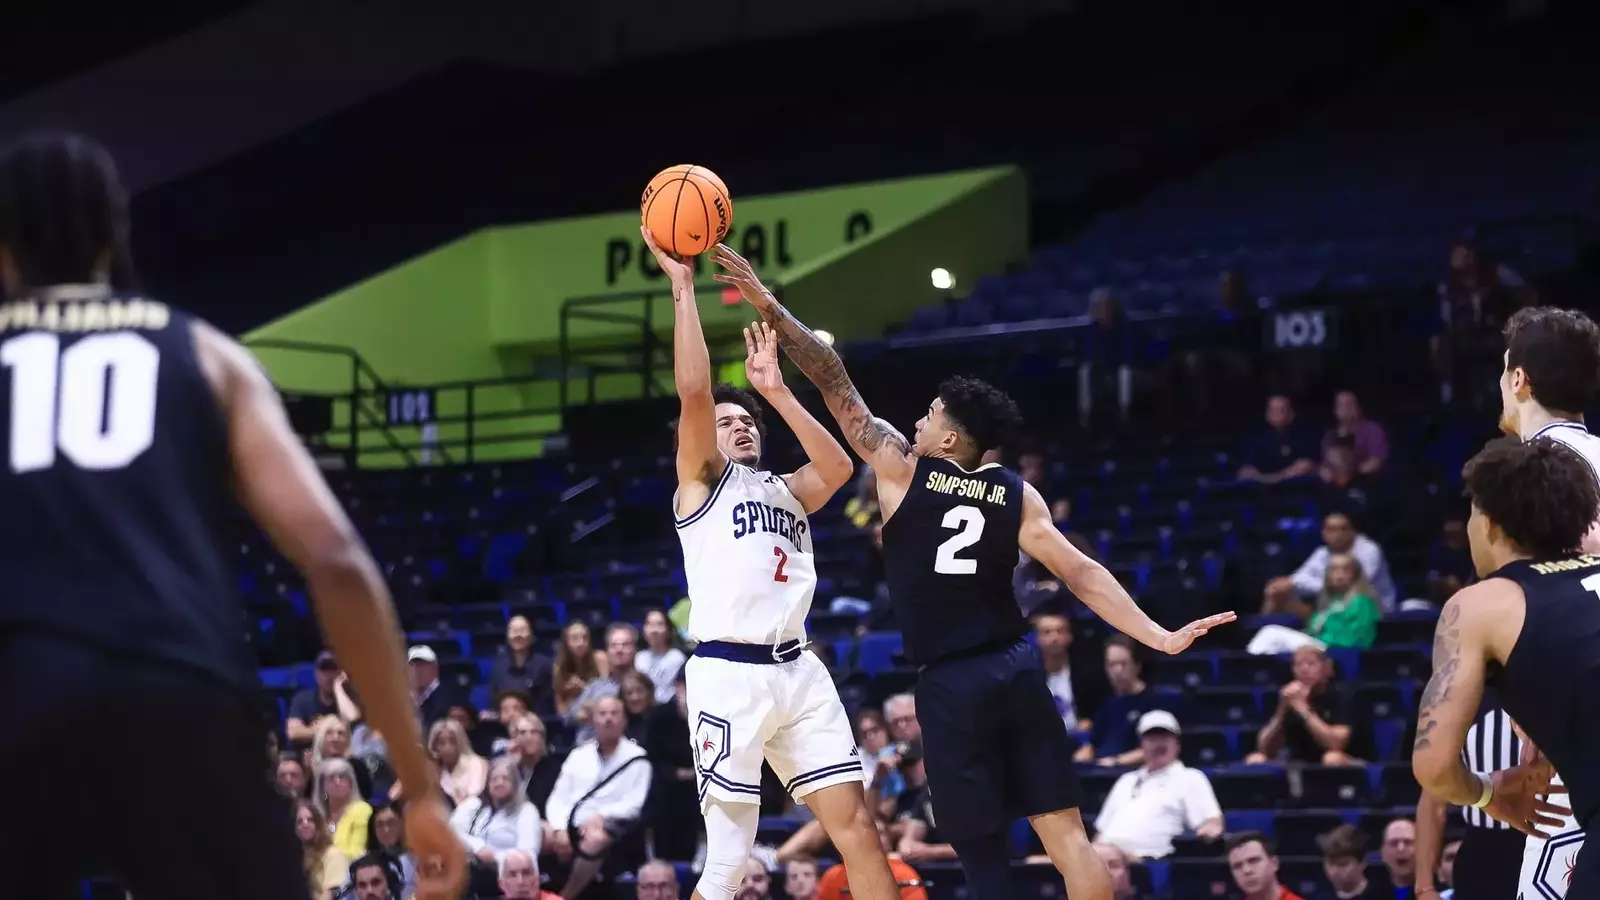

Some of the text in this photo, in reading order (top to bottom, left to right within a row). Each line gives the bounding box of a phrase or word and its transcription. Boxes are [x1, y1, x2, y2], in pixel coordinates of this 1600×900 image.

[1275, 311, 1326, 347] 103
[0, 331, 160, 473] 10
[925, 471, 1007, 506] SIMPSON JR.
[732, 501, 807, 554] SPIDERS
[934, 504, 986, 575] 2
[773, 545, 789, 582] 2
